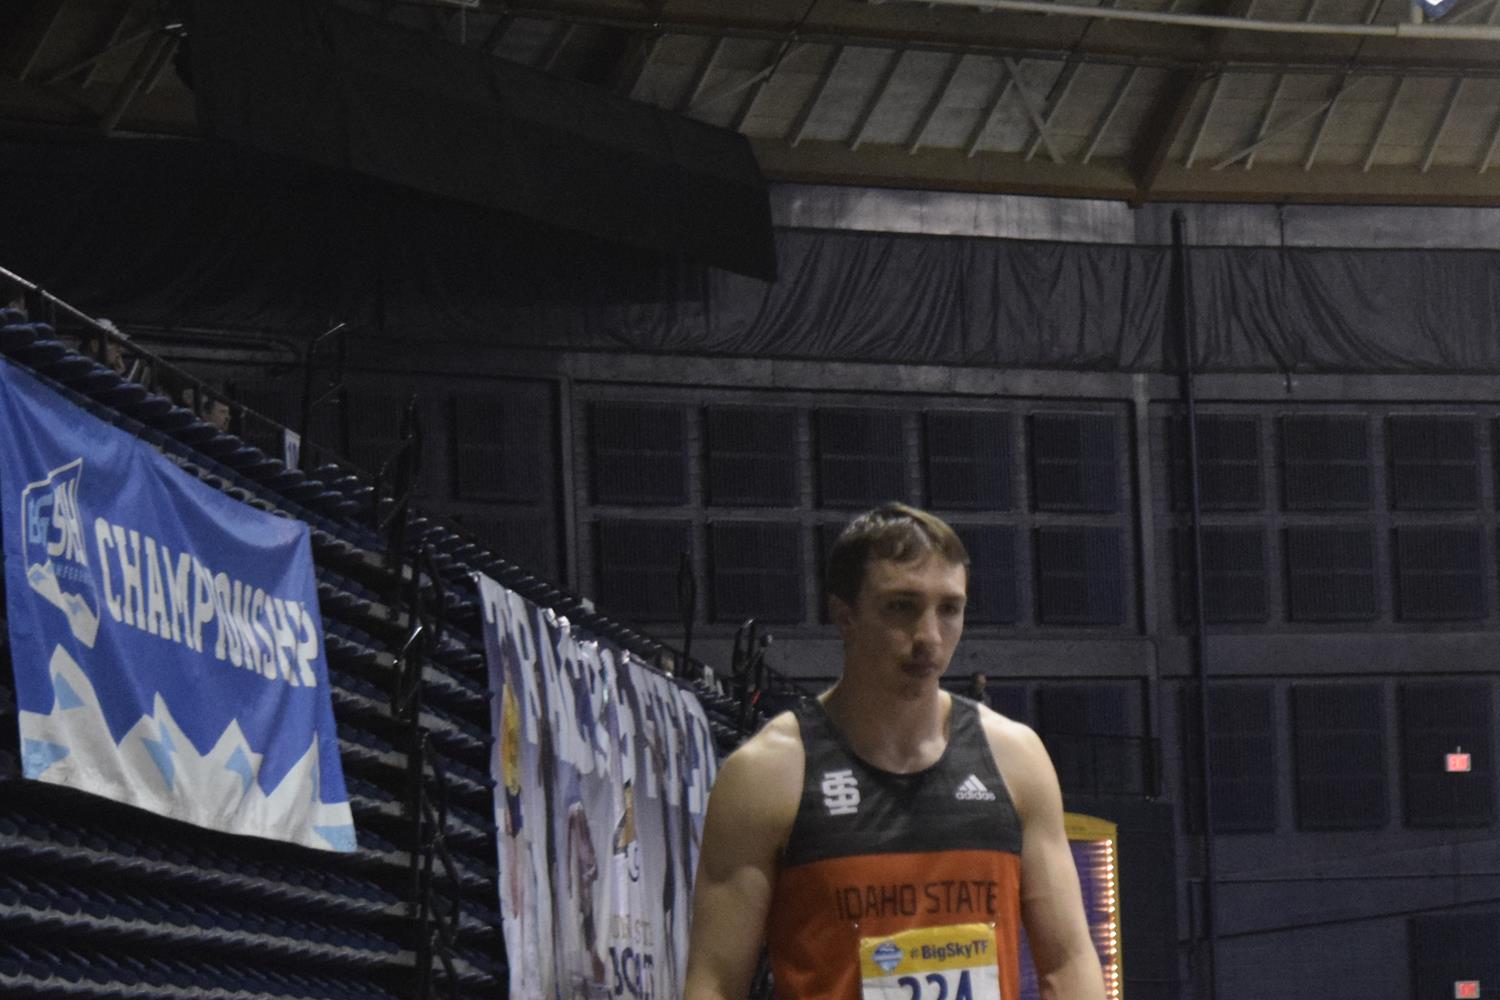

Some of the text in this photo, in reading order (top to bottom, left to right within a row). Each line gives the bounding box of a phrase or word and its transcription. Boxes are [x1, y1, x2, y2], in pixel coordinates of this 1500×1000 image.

[955, 791, 996, 801] adidas
[836, 880, 998, 920] IDAHO STATE
[910, 940, 988, 961] #BigSkyTF
